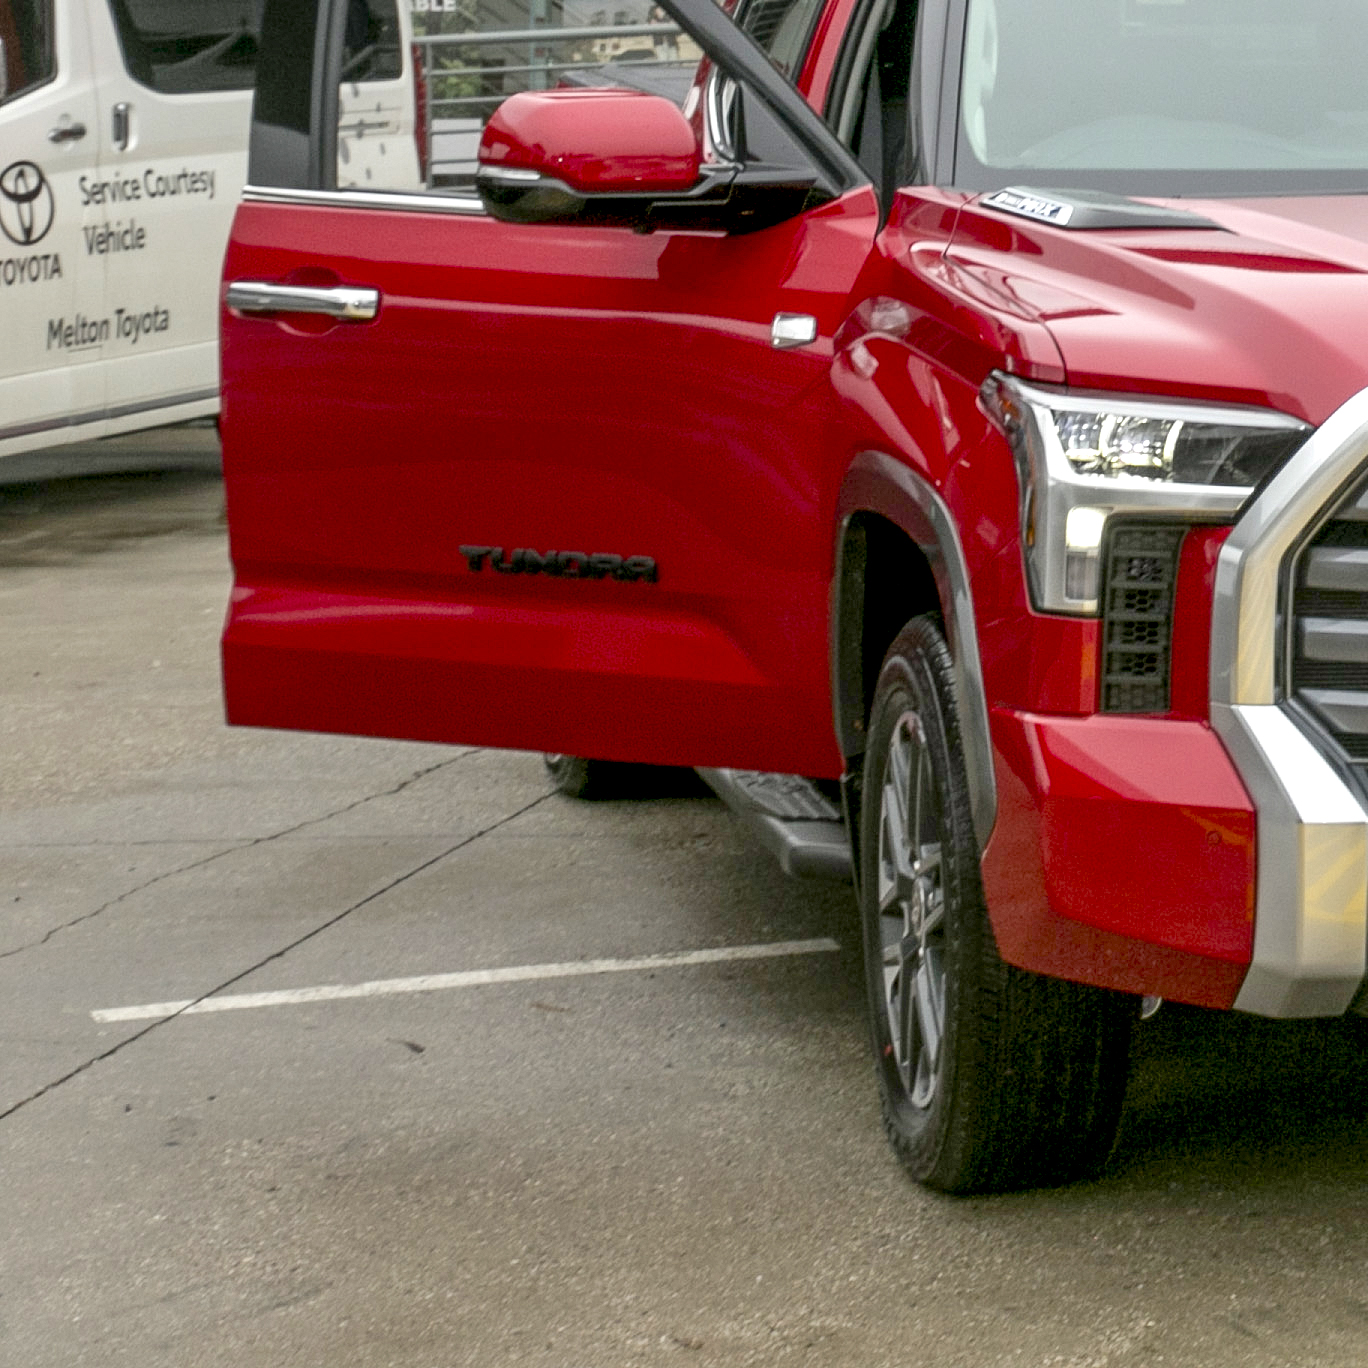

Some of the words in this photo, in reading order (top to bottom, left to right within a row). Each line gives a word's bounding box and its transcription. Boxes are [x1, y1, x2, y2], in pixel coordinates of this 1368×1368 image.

[79, 172, 141, 206] Service
[143, 167, 215, 199] Courtesy
[83, 219, 146, 255] Vehicle
[46, 314, 110, 351] Melton
[114, 305, 170, 345] Toyota
[458, 544, 658, 583] TUNDRA
